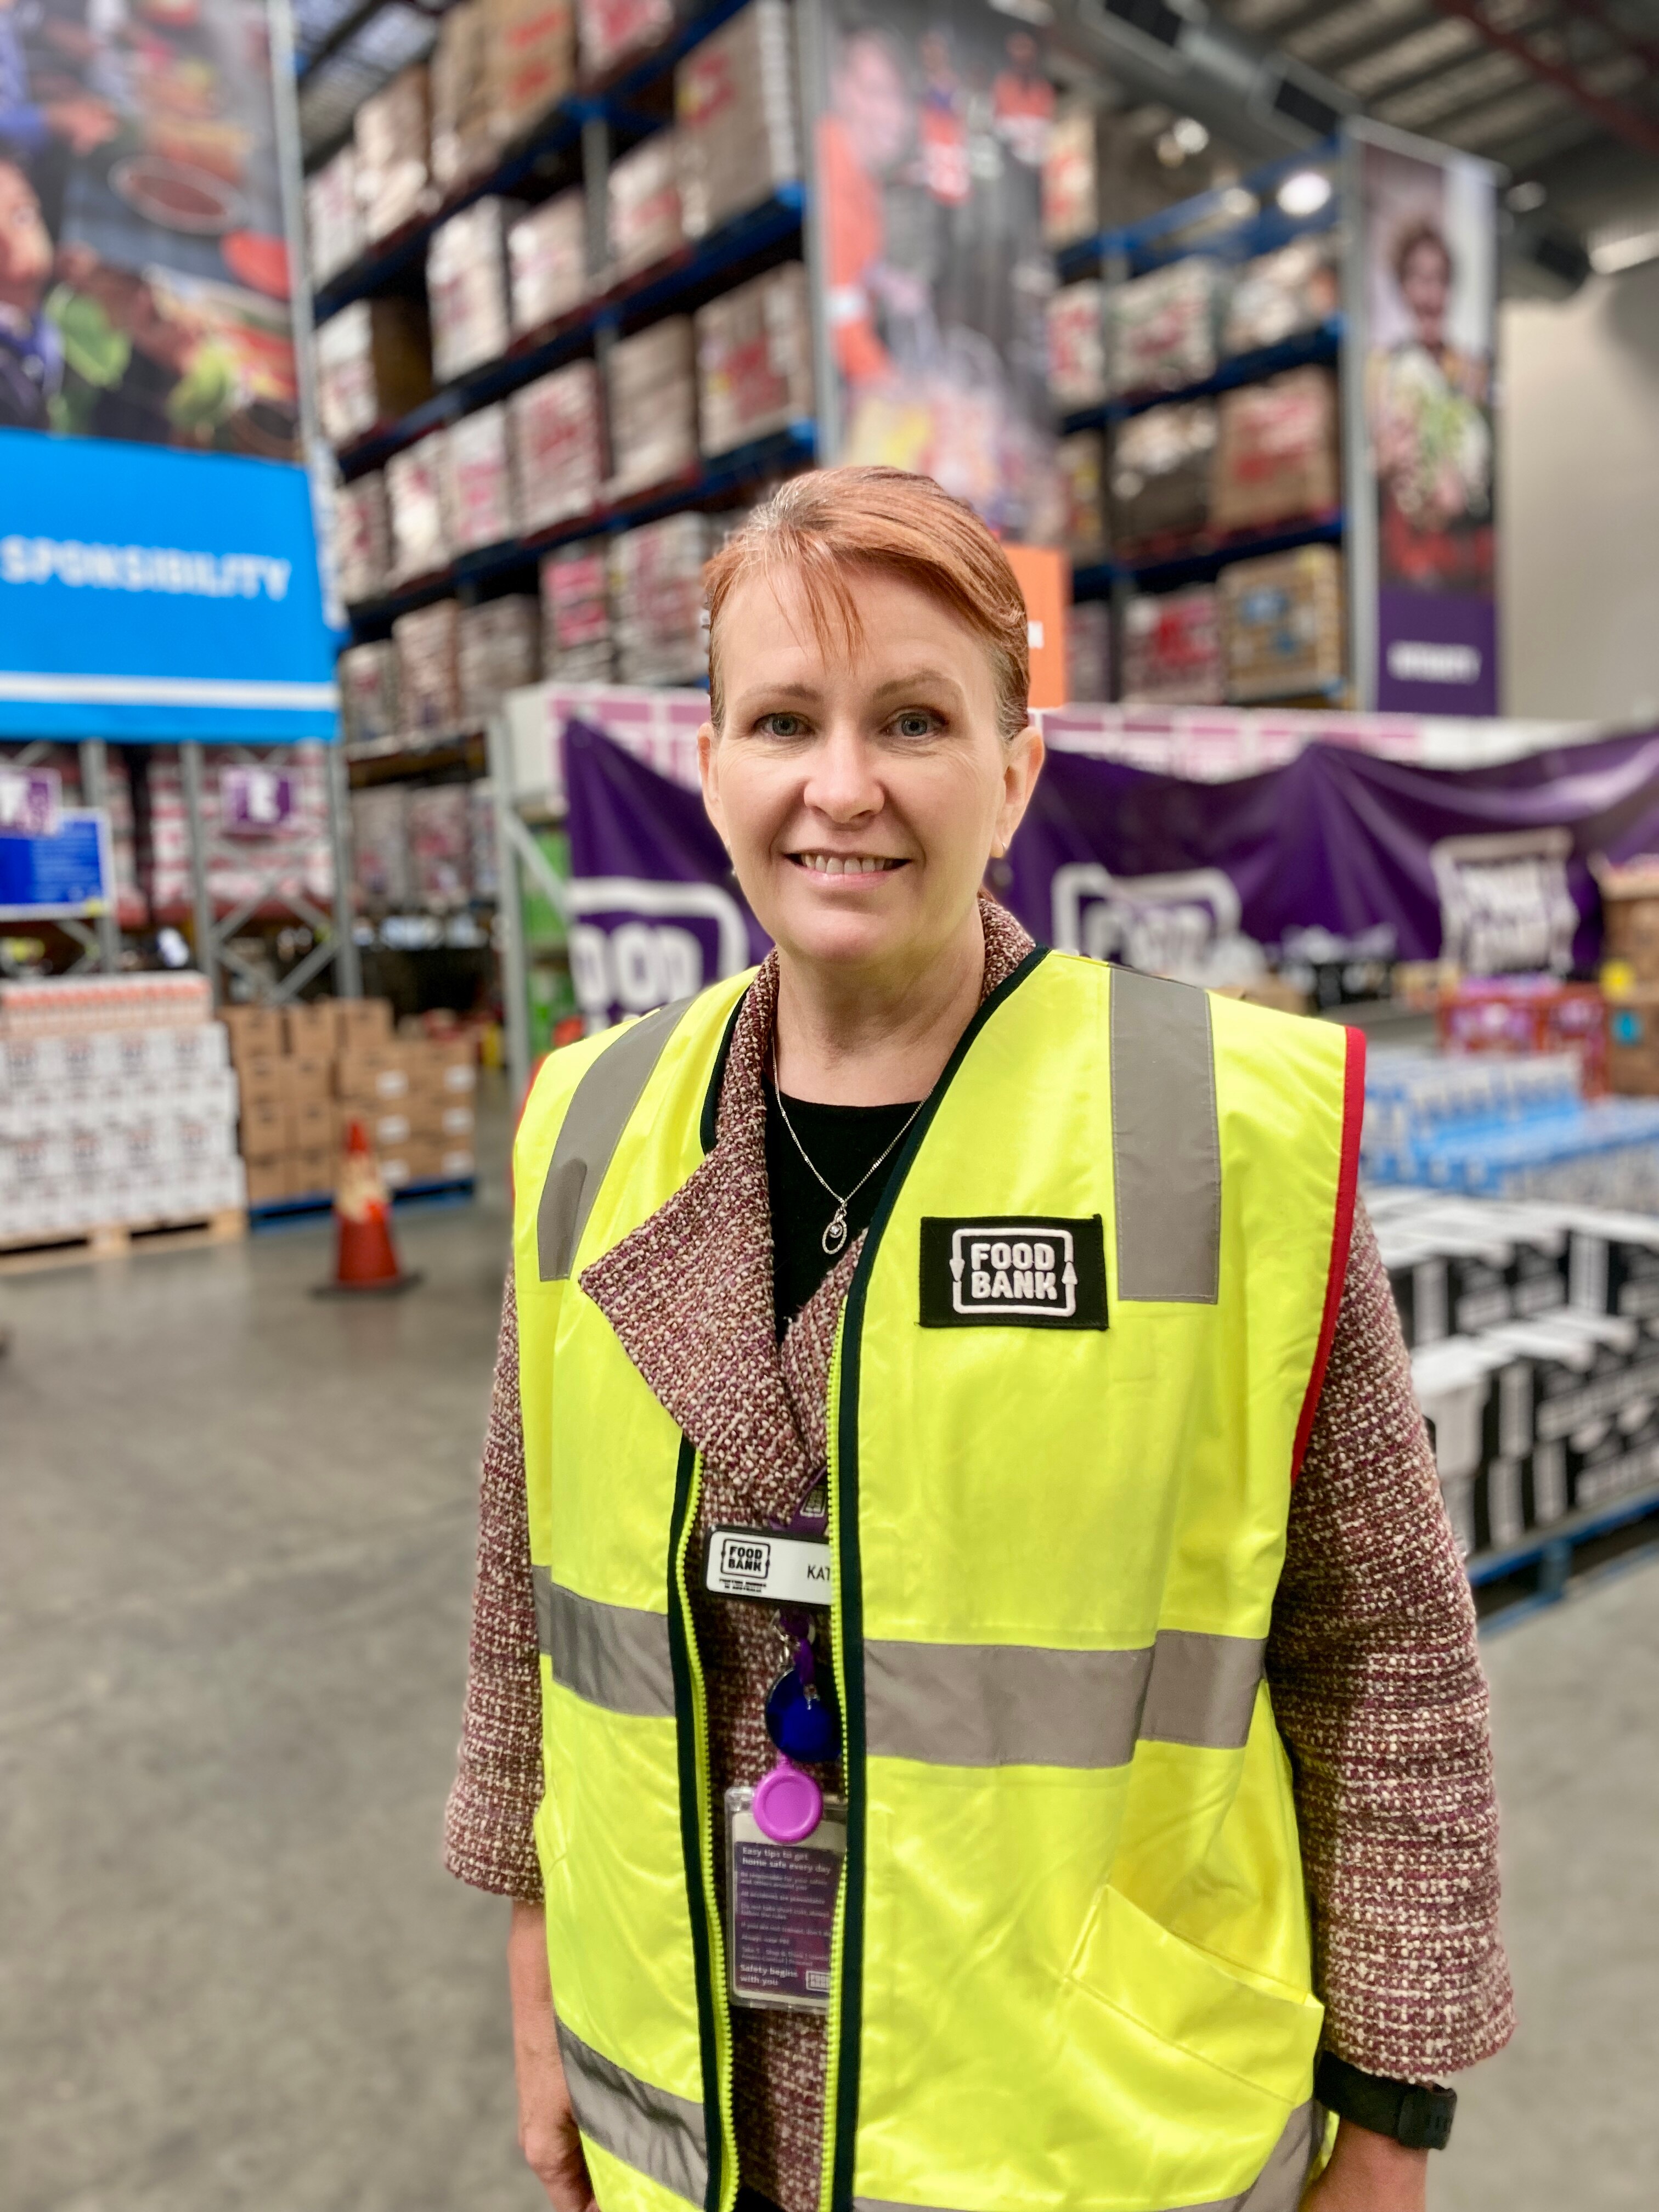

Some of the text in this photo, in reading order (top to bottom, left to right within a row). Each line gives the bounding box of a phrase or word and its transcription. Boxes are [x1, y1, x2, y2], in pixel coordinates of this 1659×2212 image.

[970, 1242, 1055, 1271] FOOD
[971, 1271, 1057, 1300] BANK
[730, 1546, 763, 1559] FOOD
[728, 1558, 761, 1572] BANK
[742, 1847, 761, 1858] Easy
[764, 1848, 780, 1858] tips
[742, 1857, 831, 1875] home safe every day
[740, 1964, 797, 1978] Safety begins
[740, 1975, 759, 1984] with
